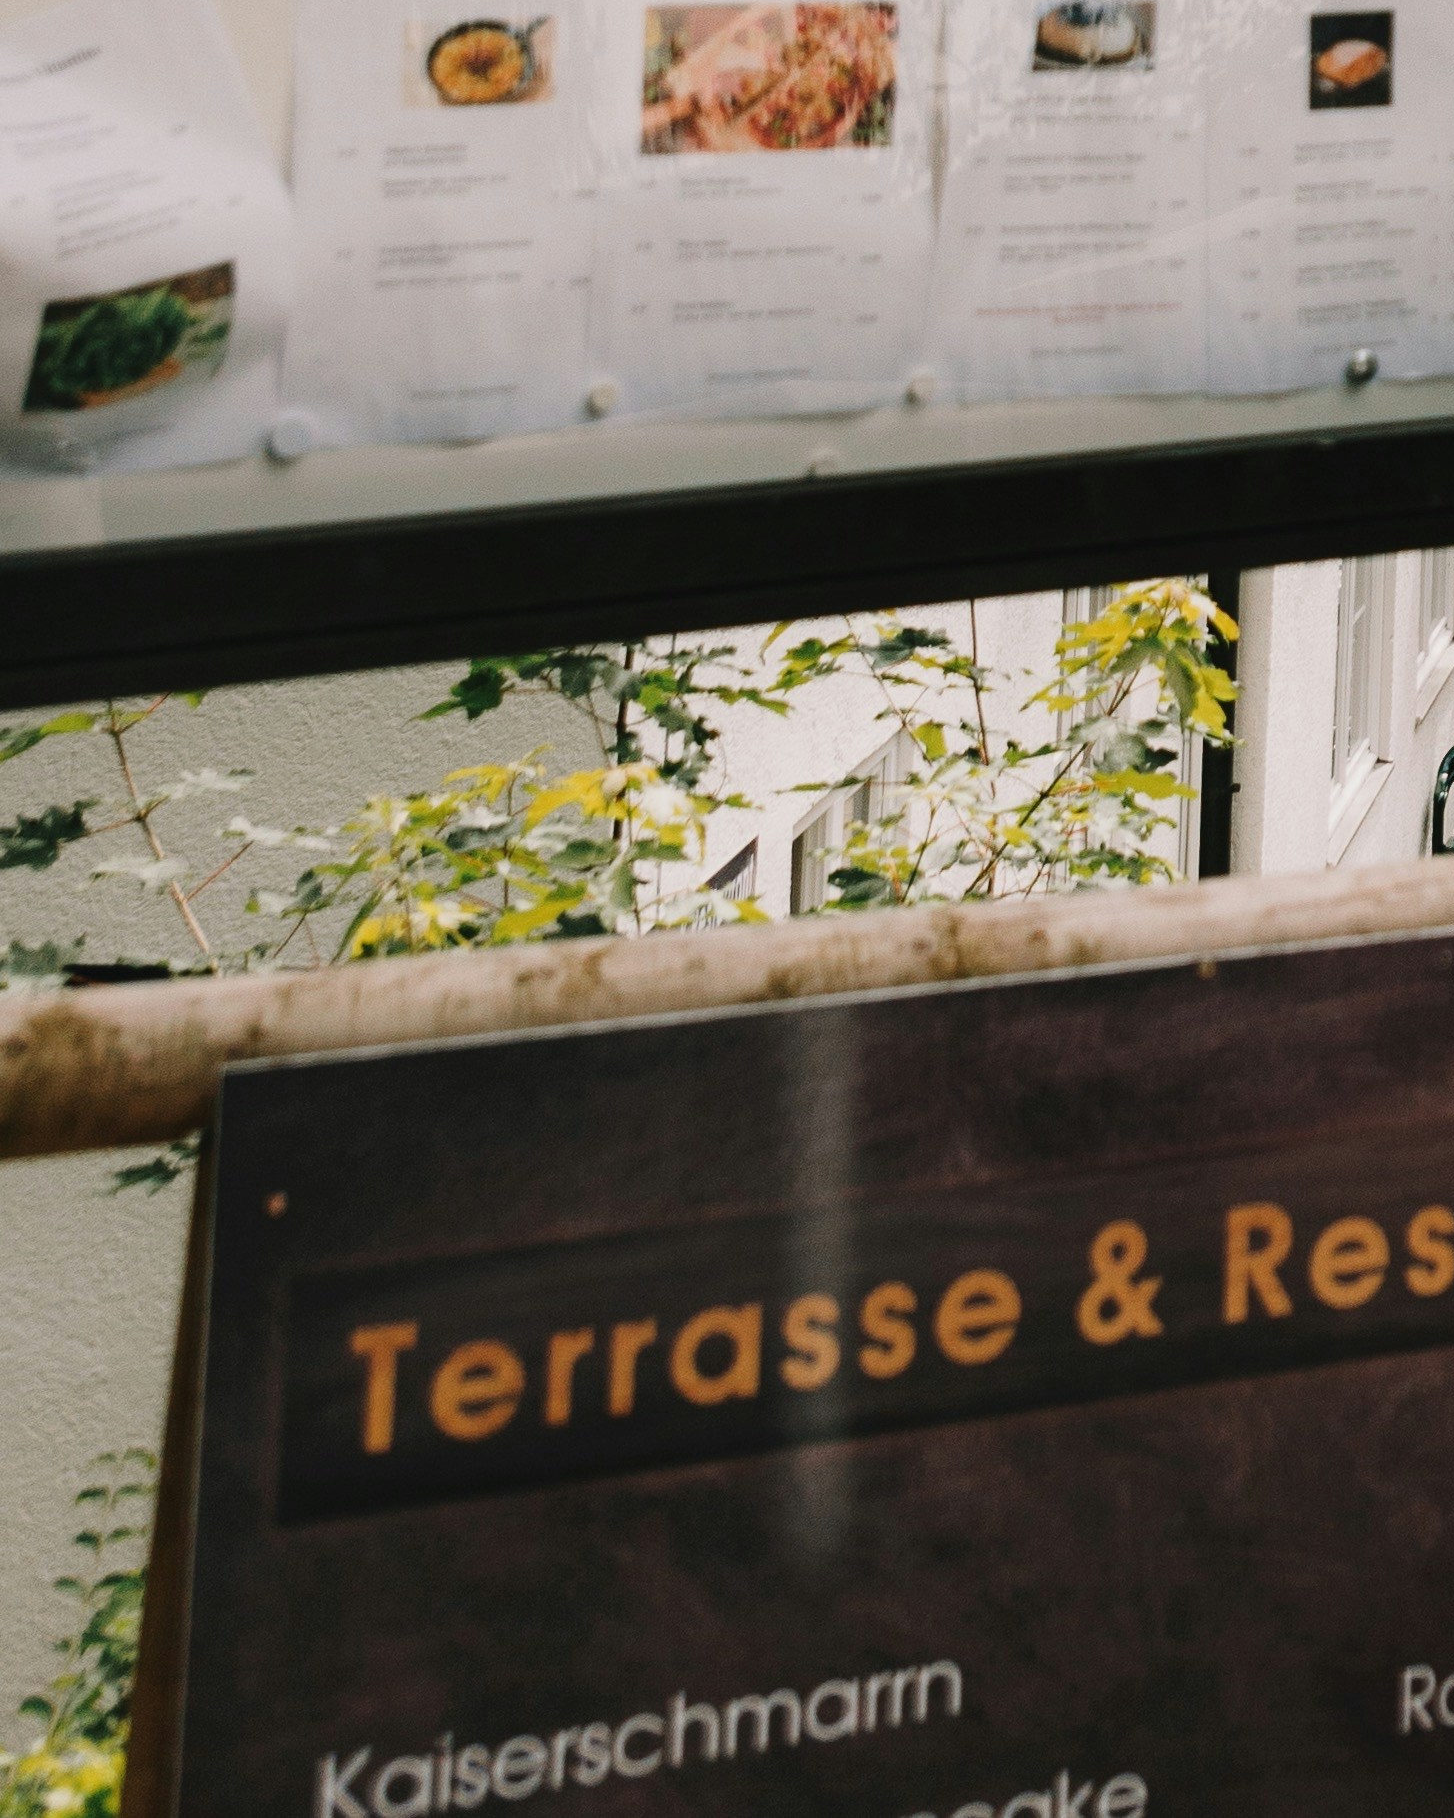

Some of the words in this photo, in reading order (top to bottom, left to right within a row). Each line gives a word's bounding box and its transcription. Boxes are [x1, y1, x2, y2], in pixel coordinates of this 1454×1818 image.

[349, 1268, 1023, 1455] Terrasse
[1075, 1218, 1165, 1346] &
[315, 1658, 964, 1818] Kaiserschmarrn
